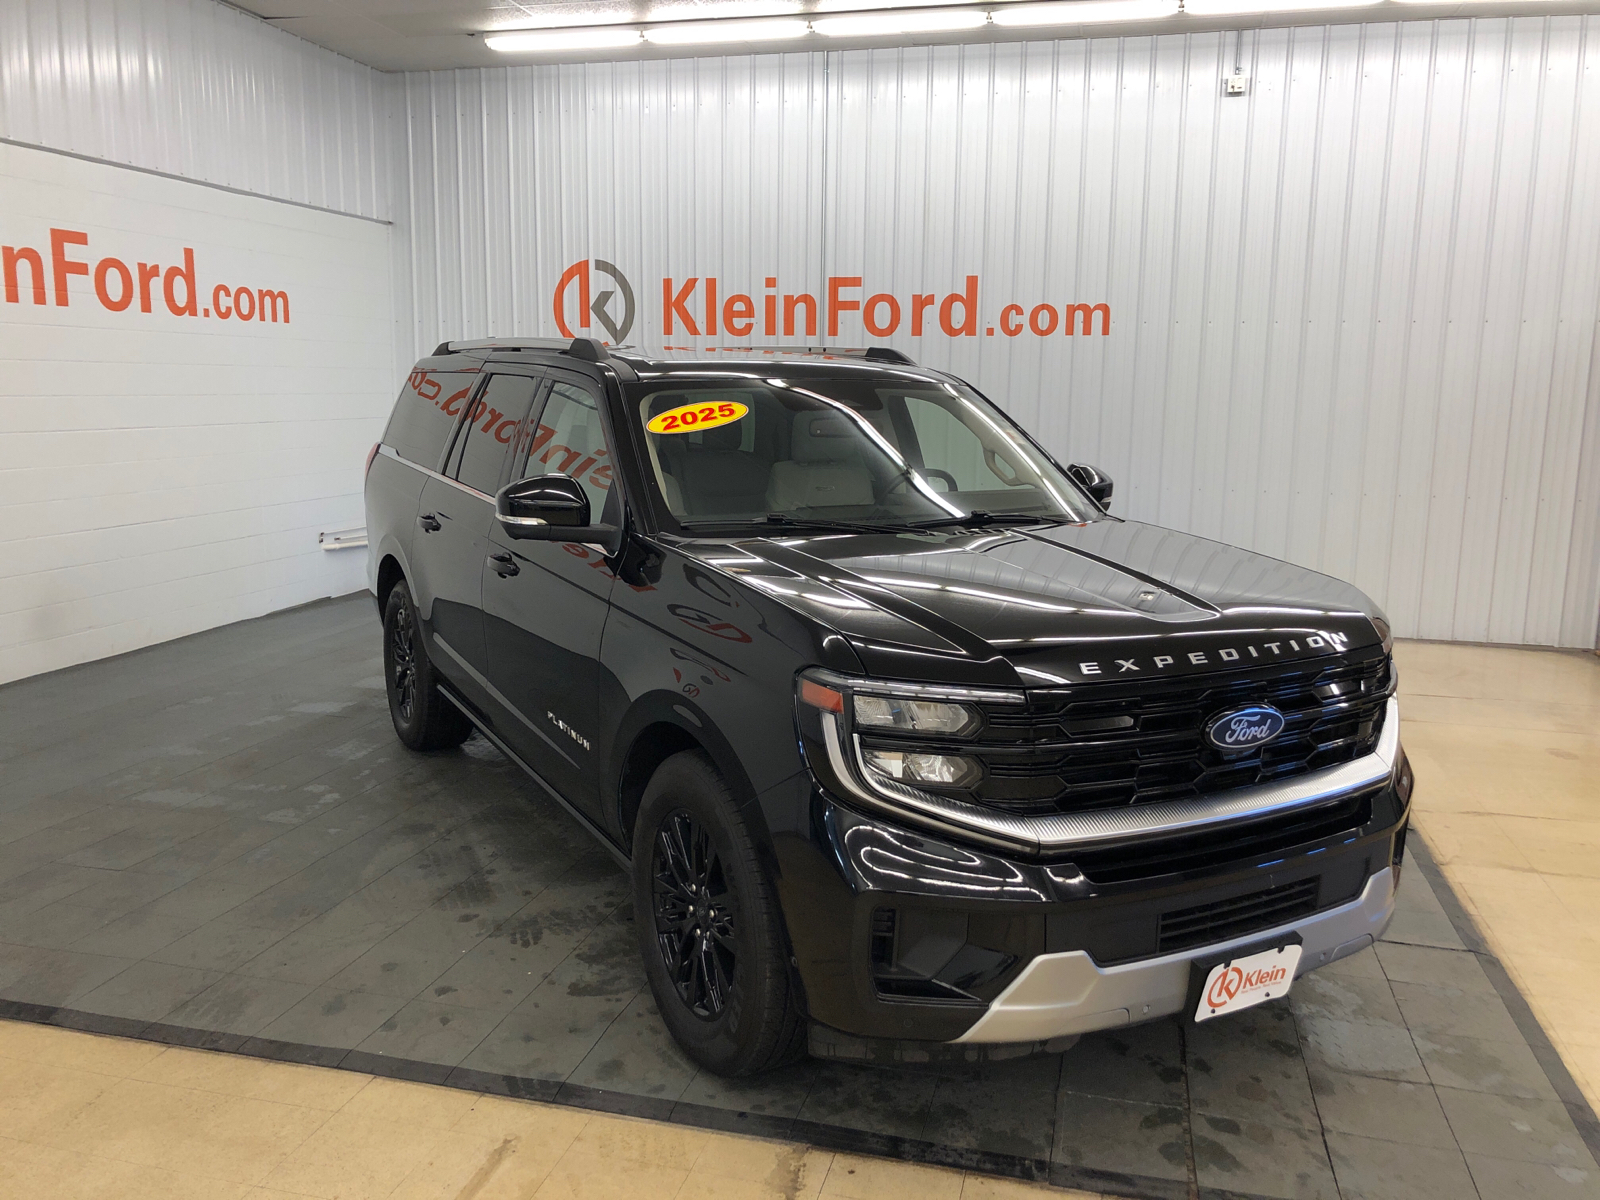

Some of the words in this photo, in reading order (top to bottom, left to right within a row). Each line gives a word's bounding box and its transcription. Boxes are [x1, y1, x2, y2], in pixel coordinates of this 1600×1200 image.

[1, 228, 290, 324] nFord.com
[663, 275, 1110, 337] KleinFord.com
[661, 403, 735, 431] 2025
[1079, 632, 1347, 675] EXPEDITION
[547, 710, 590, 751] PLATINUM
[1225, 715, 1270, 743] Ford
[1242, 965, 1287, 990] Klein
